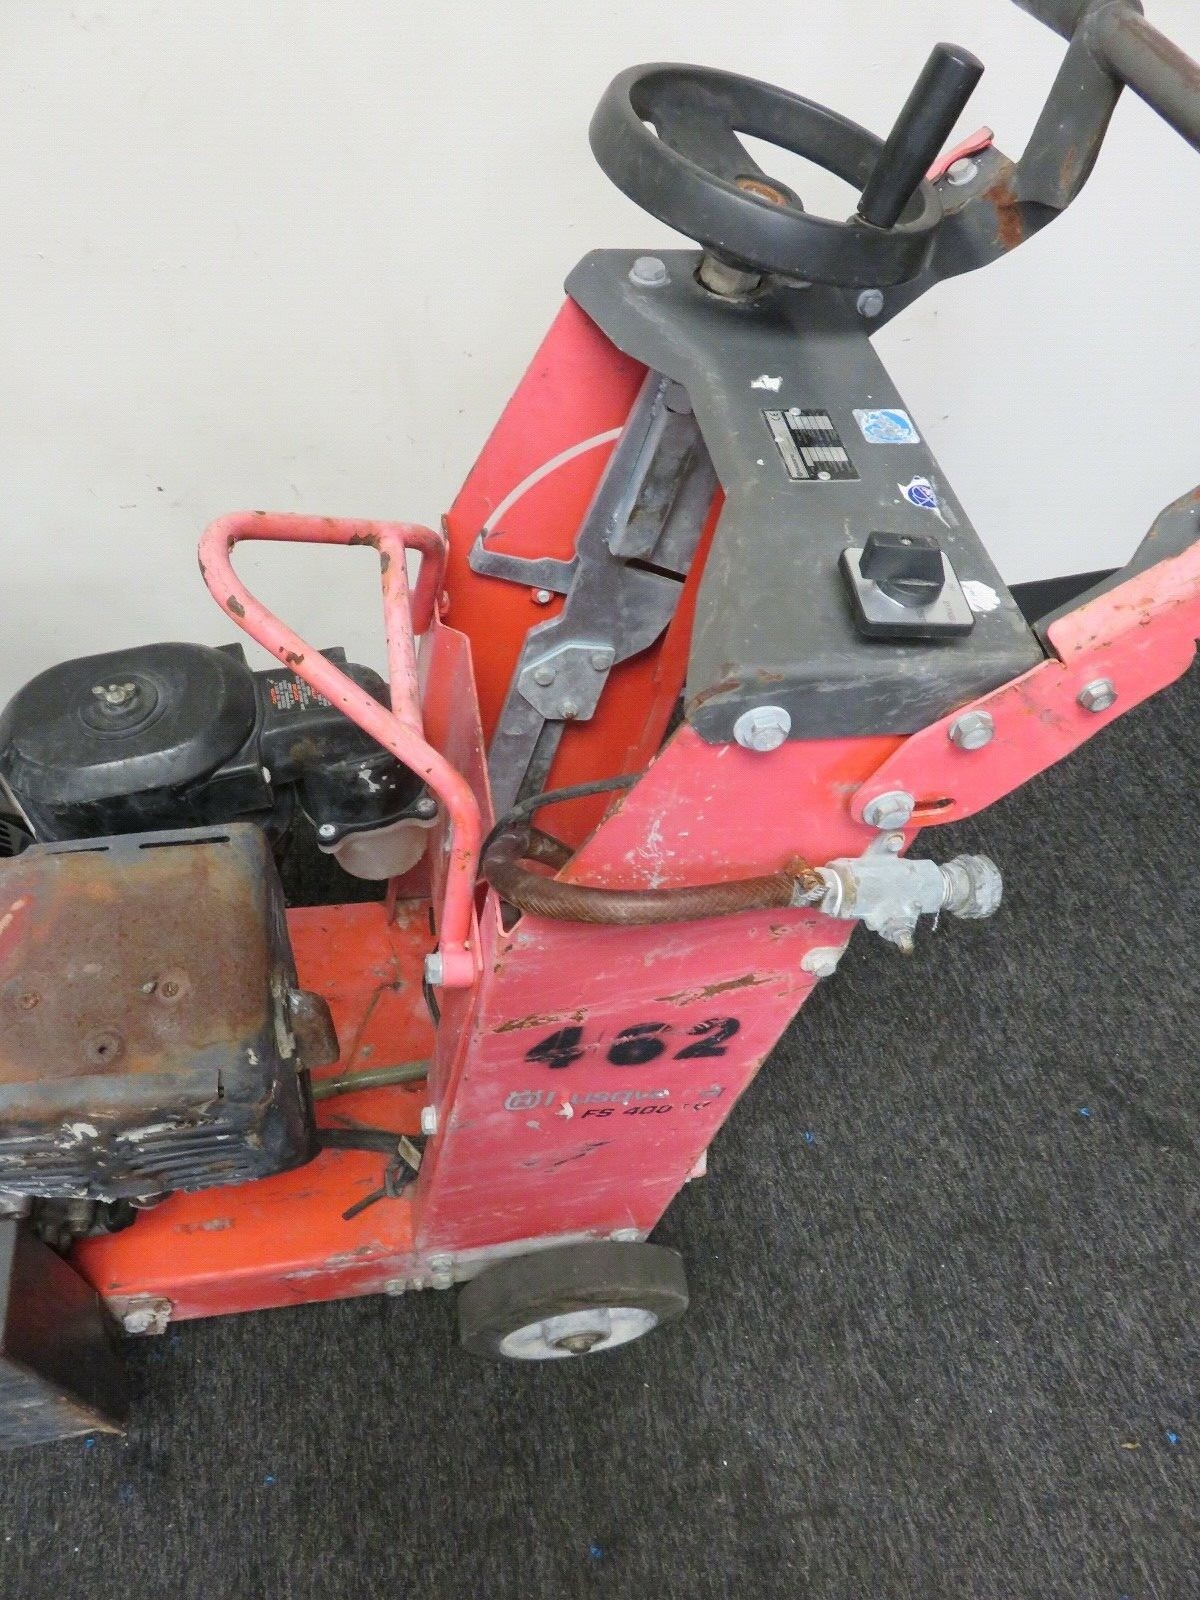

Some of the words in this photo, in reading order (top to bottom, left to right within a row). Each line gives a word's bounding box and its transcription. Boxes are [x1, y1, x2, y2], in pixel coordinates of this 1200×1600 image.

[524, 1016, 741, 1069] 462
[581, 1107, 615, 1119] FS
[623, 1103, 673, 1116] 400
